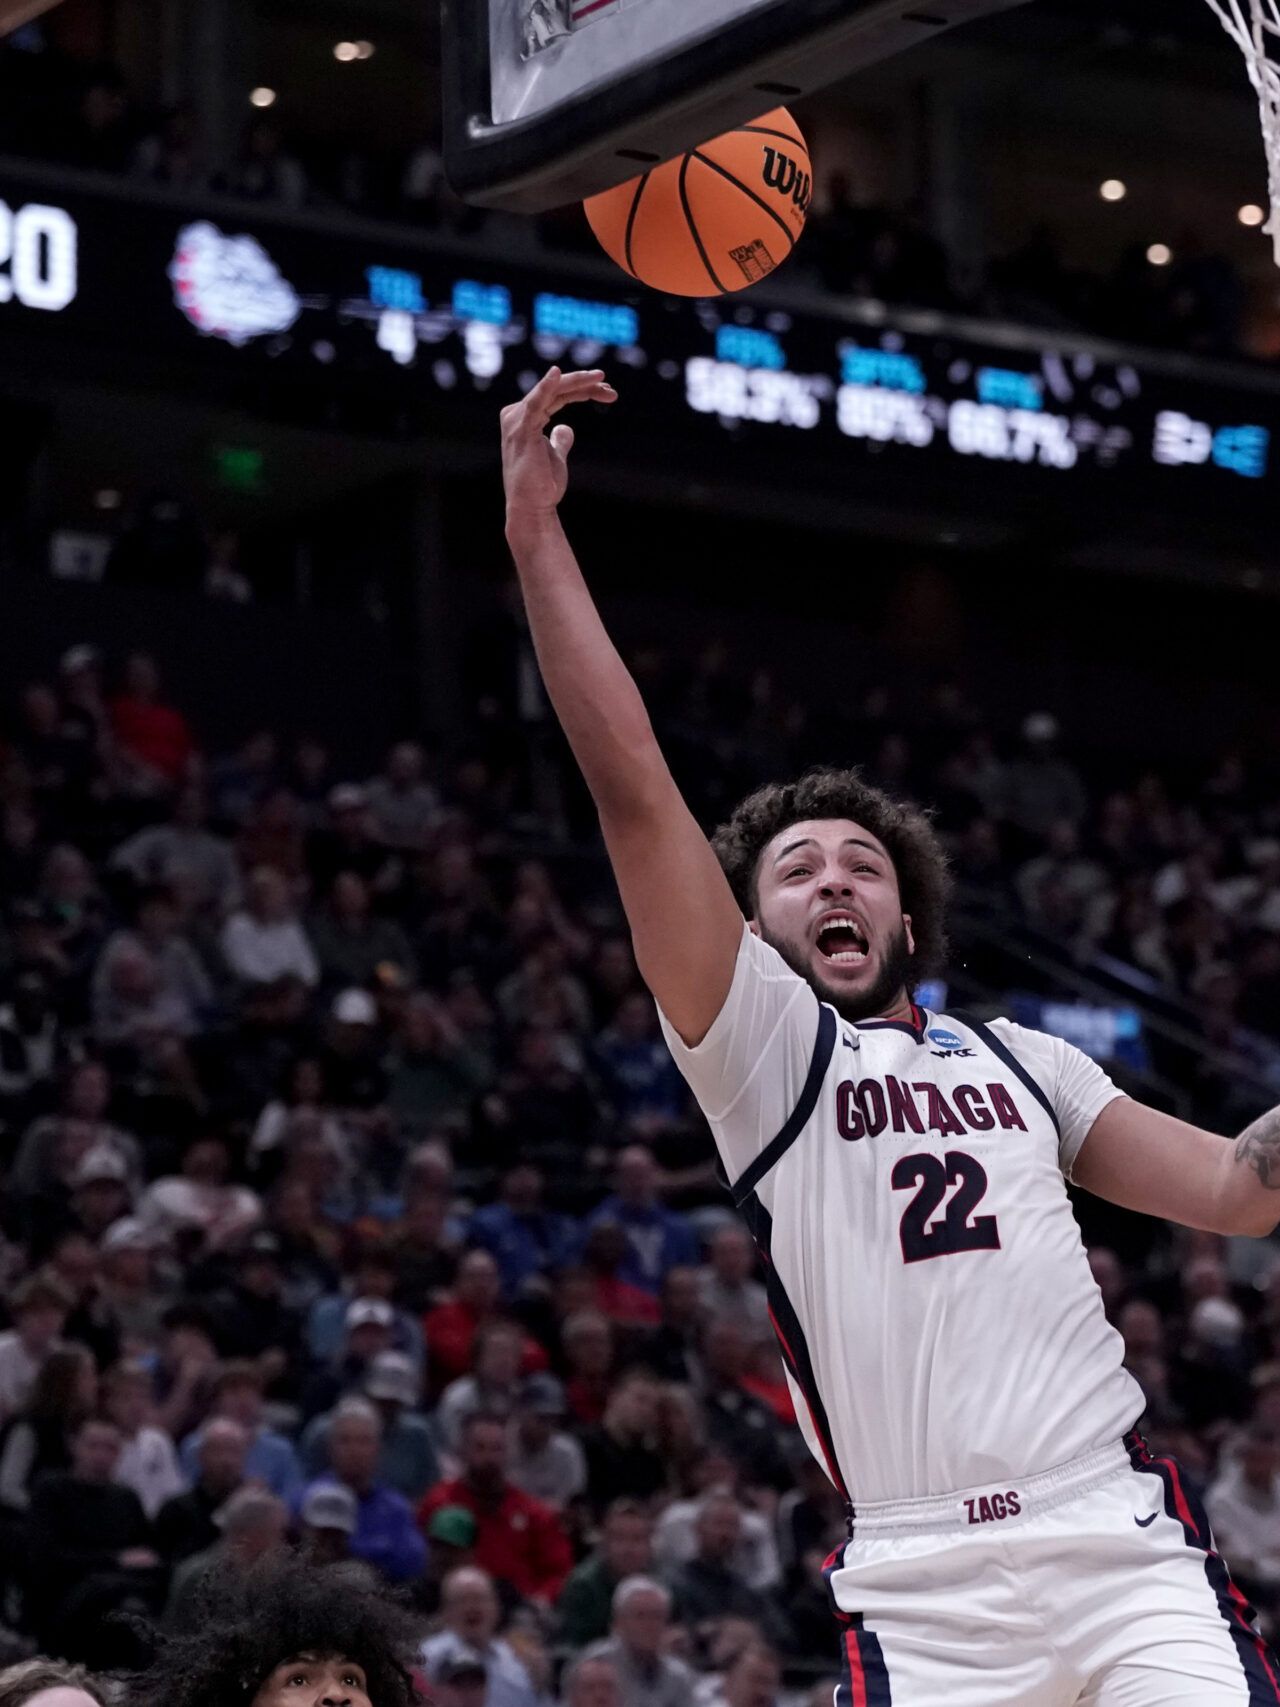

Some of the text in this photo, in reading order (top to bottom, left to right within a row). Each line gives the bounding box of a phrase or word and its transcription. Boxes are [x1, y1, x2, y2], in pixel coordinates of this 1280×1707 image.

[0, 199, 79, 312] 0
[836, 1074, 1029, 1142] GONZAGA
[891, 1150, 1002, 1265] 22
[963, 1491, 1021, 1525] ZAGS
